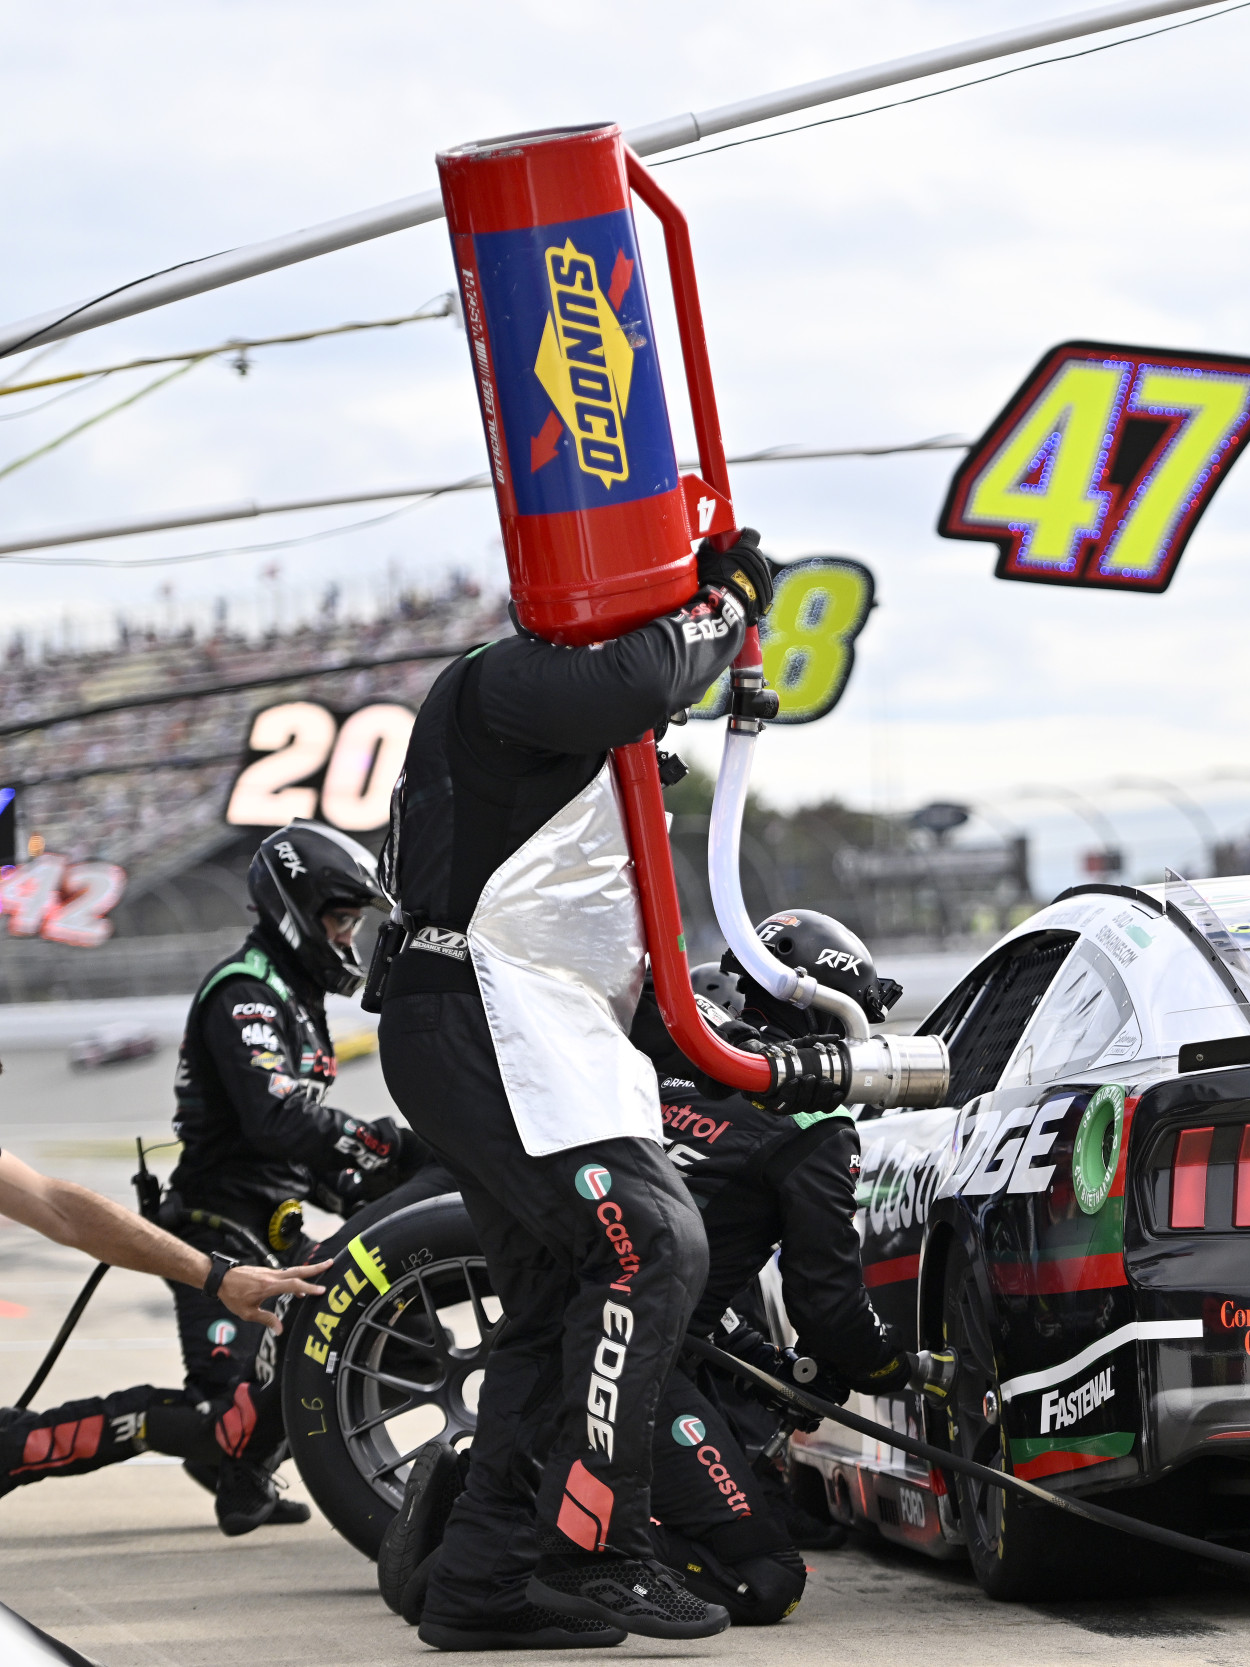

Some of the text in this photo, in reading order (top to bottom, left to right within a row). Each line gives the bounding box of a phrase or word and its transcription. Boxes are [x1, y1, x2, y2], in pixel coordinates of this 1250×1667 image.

[553, 250, 624, 474] SUNOCO
[482, 377, 493, 415] FUEL
[488, 418, 505, 484] OFFICIAL
[682, 592, 746, 644] EDGE
[227, 701, 418, 832] 20
[274, 841, 307, 879] RFK
[0, 853, 127, 946] 42
[760, 924, 784, 941] 6
[441, 947, 464, 959] WEAR
[815, 948, 863, 977] RFK
[232, 1002, 277, 1018] FORD
[660, 1103, 729, 1145] strol
[937, 1097, 1077, 1198] DGE
[596, 1200, 641, 1294] Castrol
[304, 1246, 387, 1365] EAGLE
[586, 1299, 634, 1464] EDGE
[1040, 1367, 1115, 1435] FASTENAL
[696, 1445, 752, 1520] Castr
[900, 1486, 926, 1528] FORD
